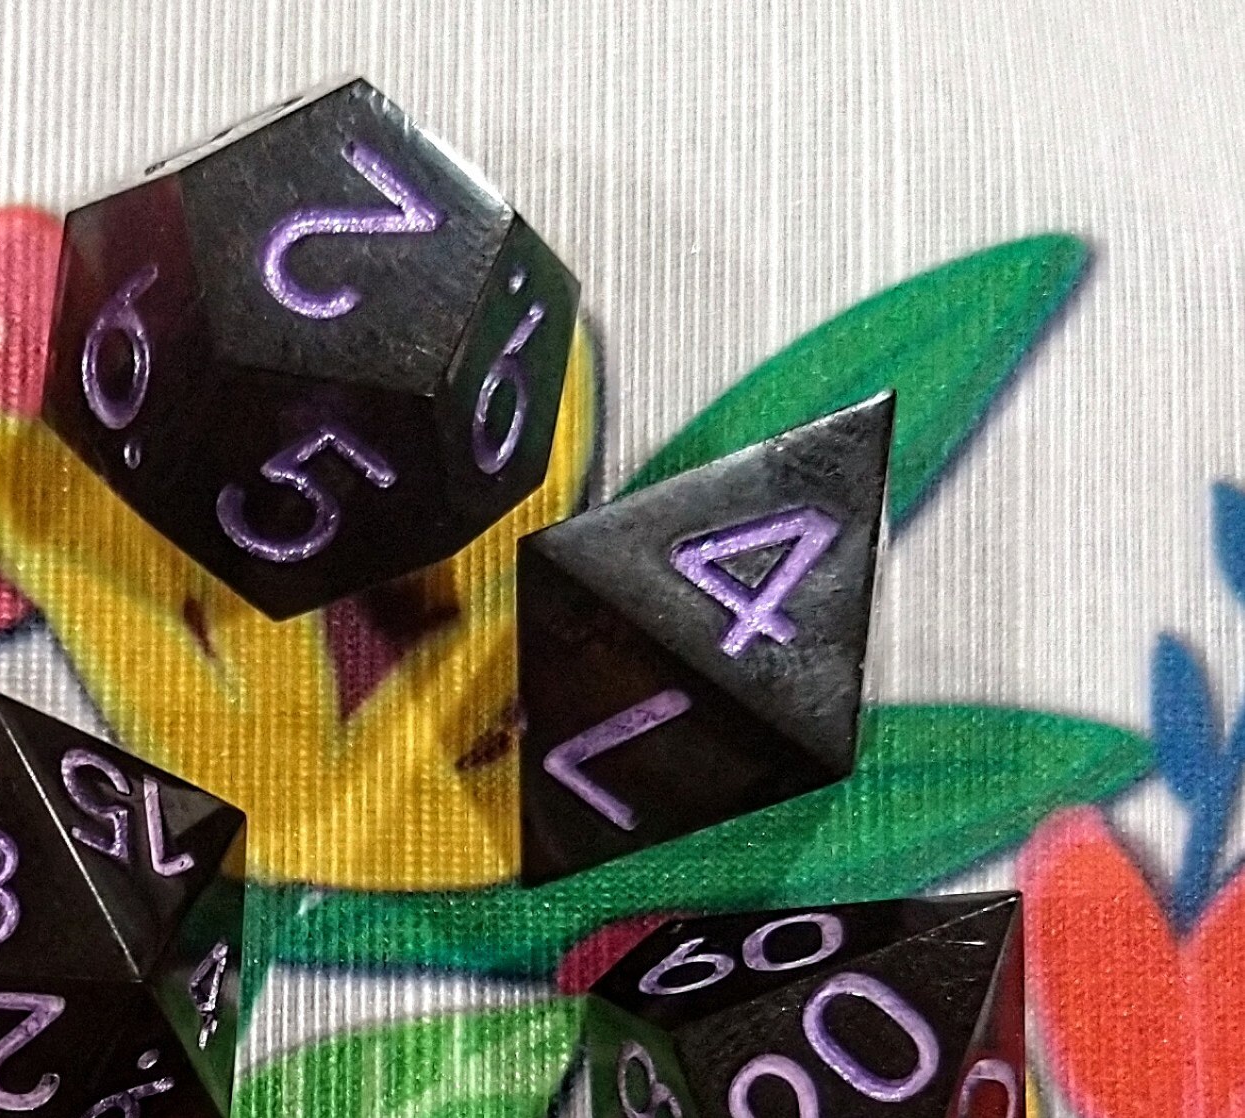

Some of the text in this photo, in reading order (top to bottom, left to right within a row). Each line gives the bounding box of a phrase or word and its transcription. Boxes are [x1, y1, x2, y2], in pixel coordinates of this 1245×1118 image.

[261, 141, 443, 319] 2
[217, 426, 396, 562] 5
[670, 505, 839, 659] 4
[61, 749, 194, 876] 15
[639, 912, 844, 994] 60
